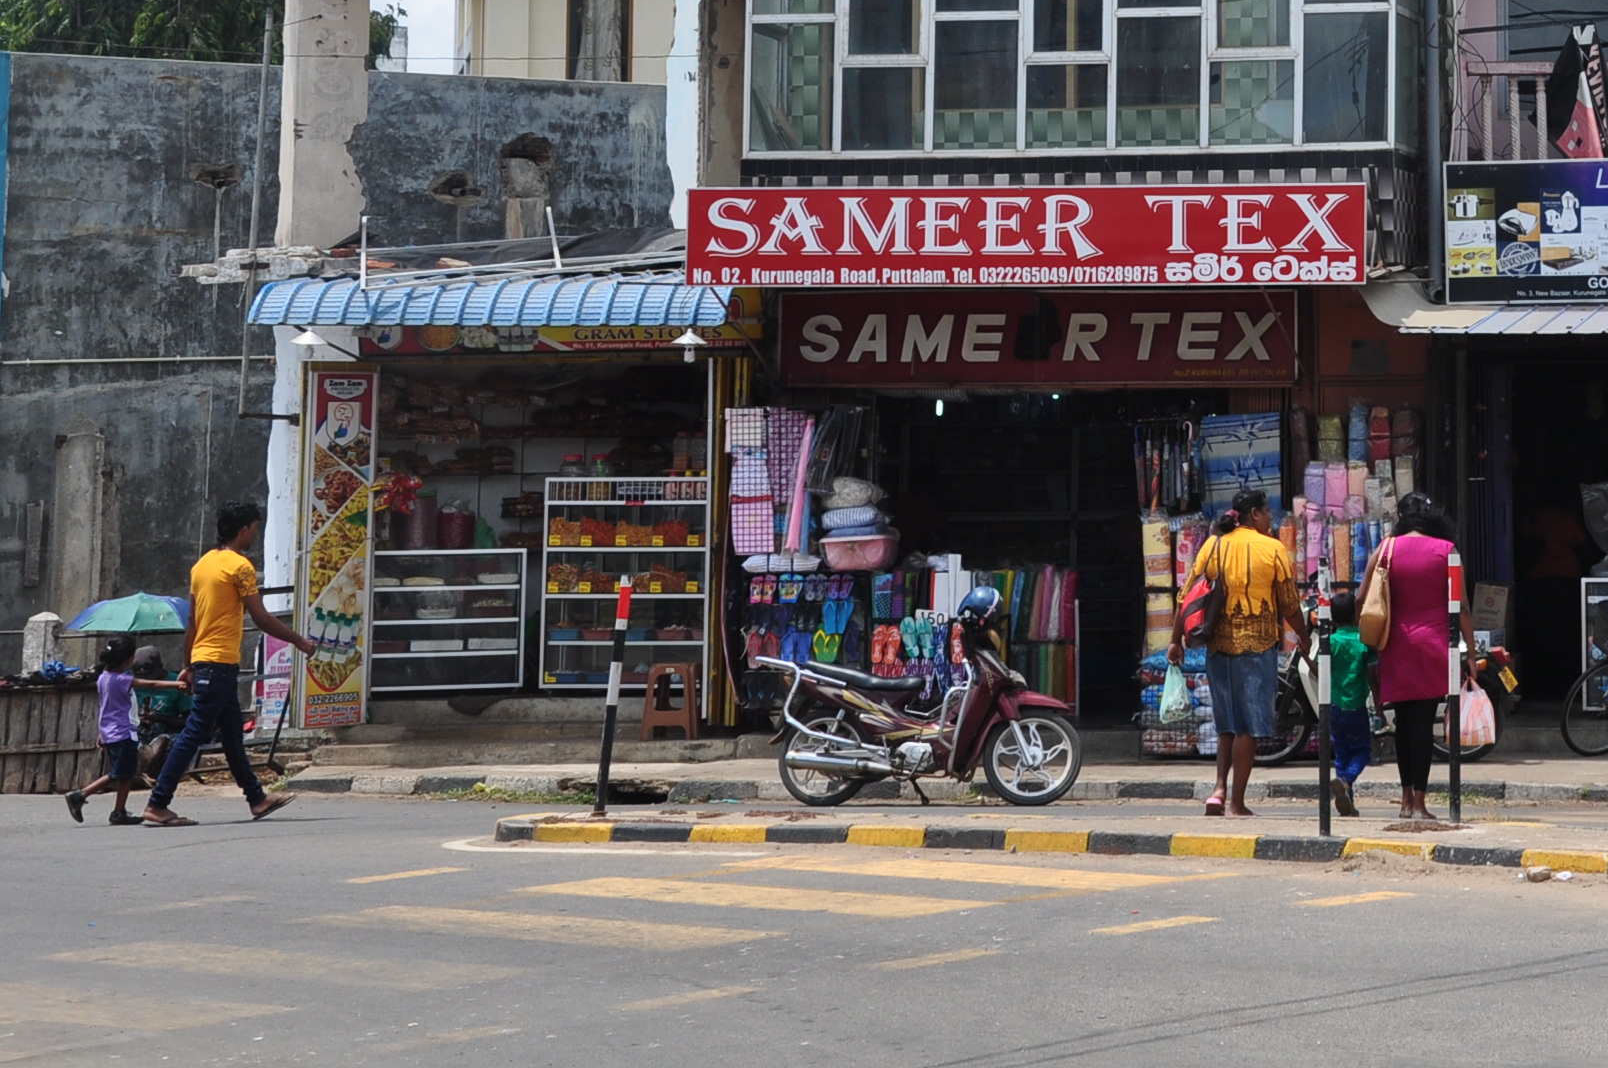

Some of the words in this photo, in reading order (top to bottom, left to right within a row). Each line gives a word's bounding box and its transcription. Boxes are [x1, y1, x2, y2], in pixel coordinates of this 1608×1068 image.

[705, 194, 1104, 261] SAMEER
[1144, 193, 1353, 253] TEX
[693, 267, 716, 284] No.
[721, 267, 746, 285] 02,
[751, 267, 834, 285] Kurunegala
[952, 267, 976, 283] Tel.
[1535, 289, 1549, 297] New
[1550, 289, 1572, 298] Bazaar,
[574, 328, 636, 341] GRAM
[1131, 311, 1282, 362] TEX
[329, 379, 345, 387] Zam
[347, 379, 363, 387] Zam
[308, 695, 322, 705] 032
